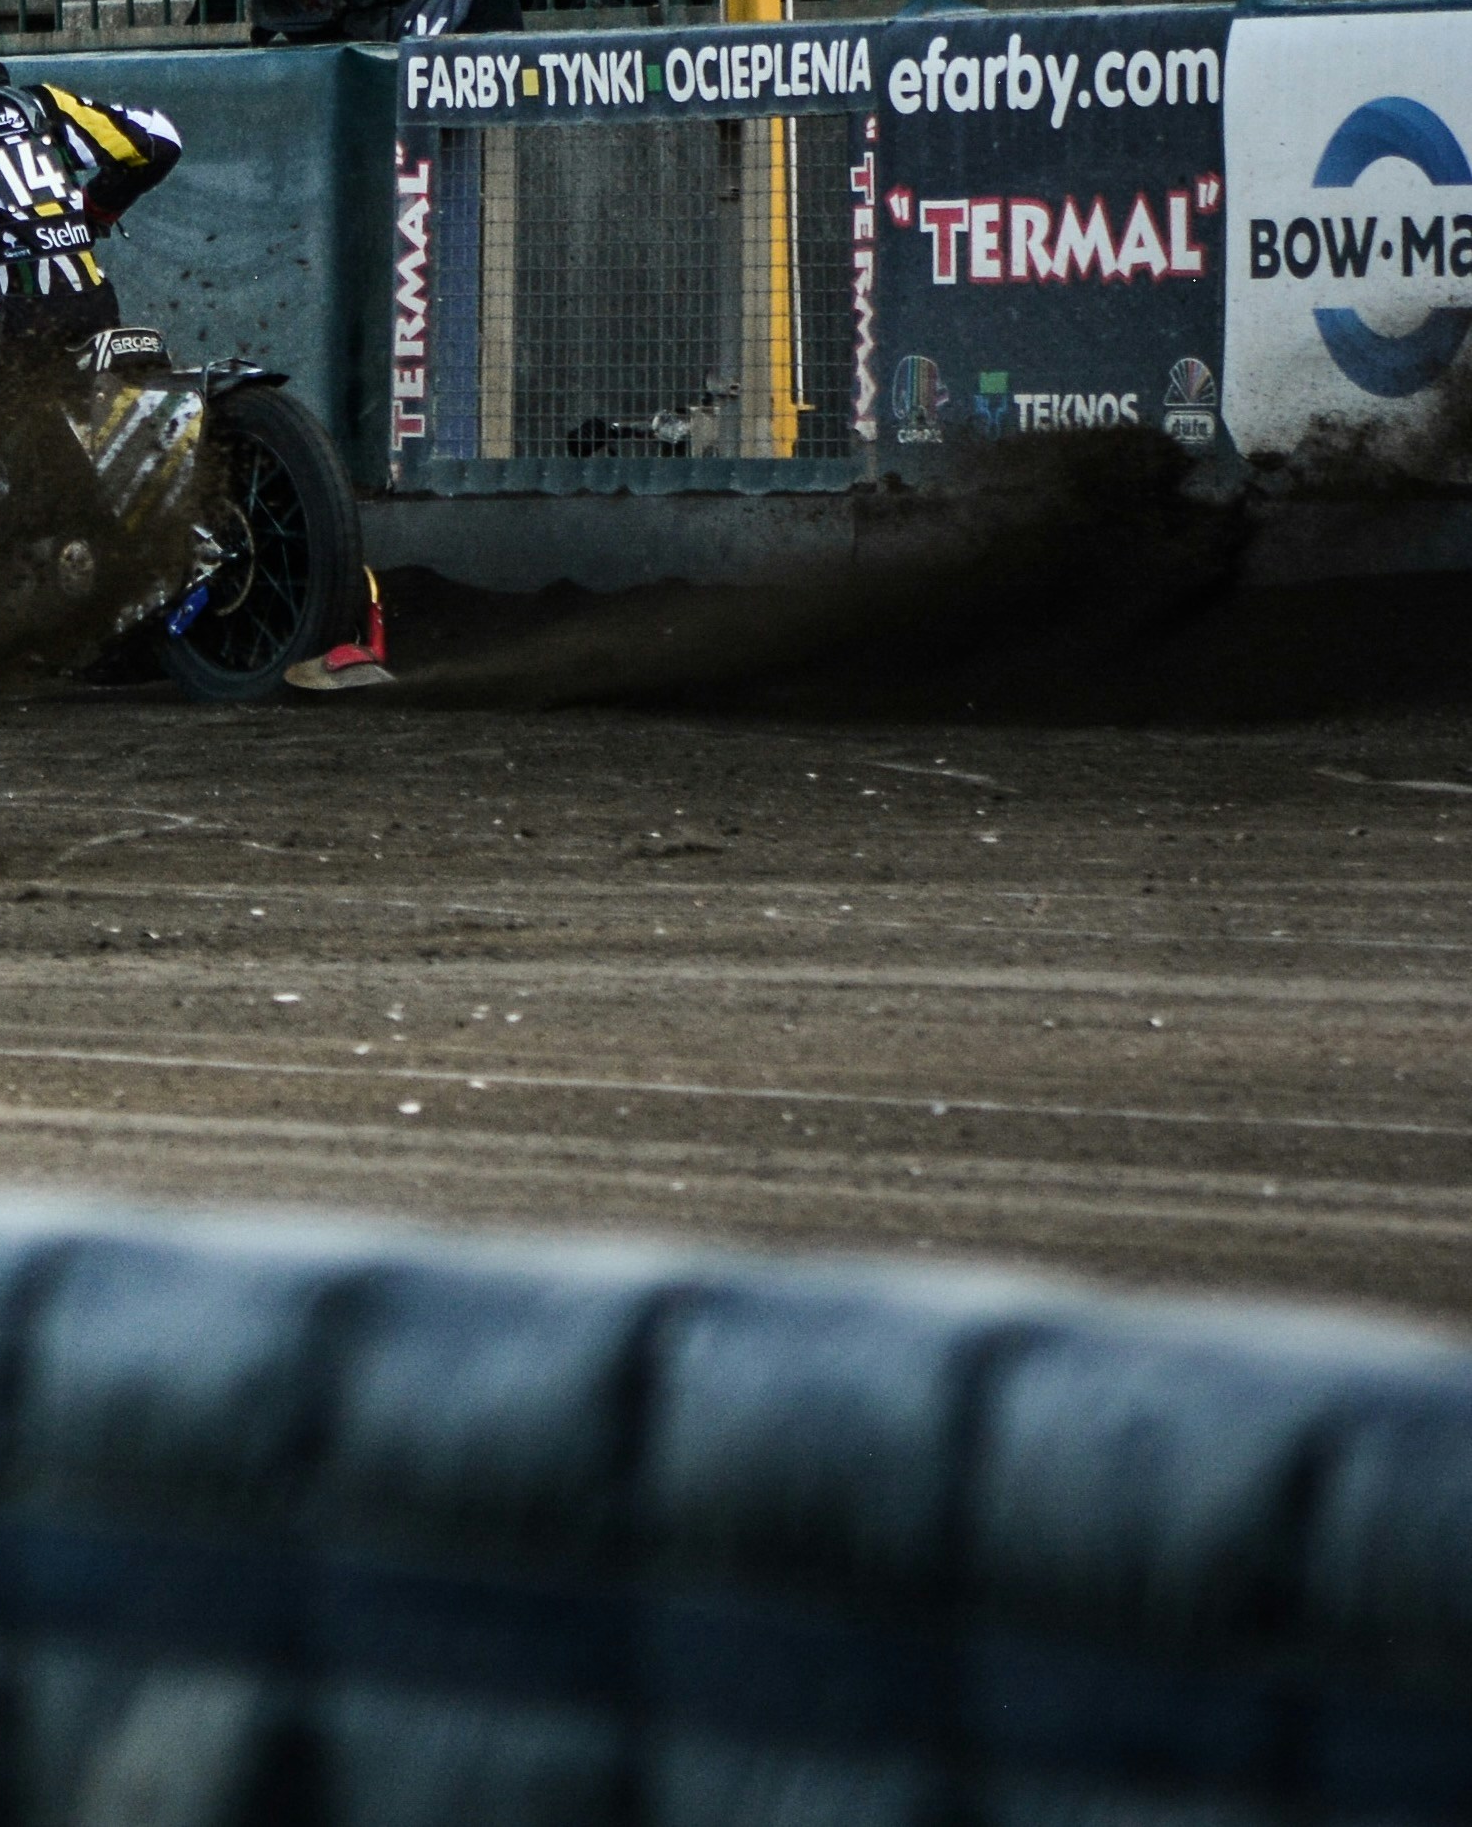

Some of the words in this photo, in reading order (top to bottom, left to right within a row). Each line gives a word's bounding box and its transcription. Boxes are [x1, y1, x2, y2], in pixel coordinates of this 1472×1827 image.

[407, 54, 520, 111] FARBY
[538, 48, 645, 105] TYNKI
[664, 37, 873, 103] OCIEPLENIA
[887, 33, 1221, 130] efarby.com
[1013, 392, 1139, 432] TEKNOS
